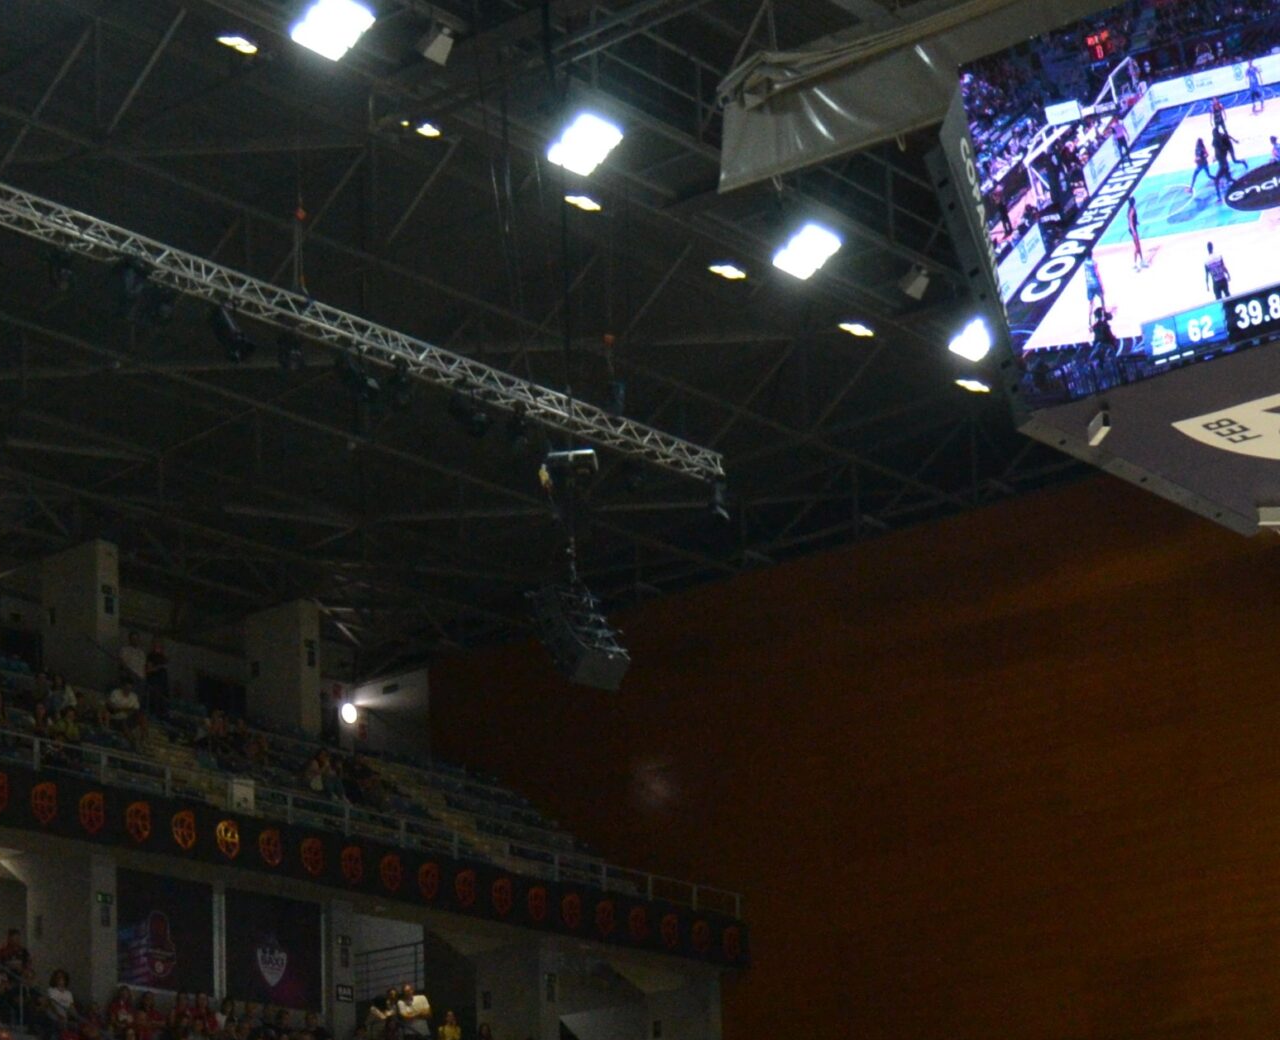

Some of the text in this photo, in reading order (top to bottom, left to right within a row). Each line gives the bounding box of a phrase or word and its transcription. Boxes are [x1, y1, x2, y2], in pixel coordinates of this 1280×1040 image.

[1227, 176, 1280, 202] end
[1020, 221, 1104, 302] COPA
[1234, 292, 1280, 330] 39.8
[1187, 314, 1215, 342] 62
[1201, 417, 1262, 444] FEB
